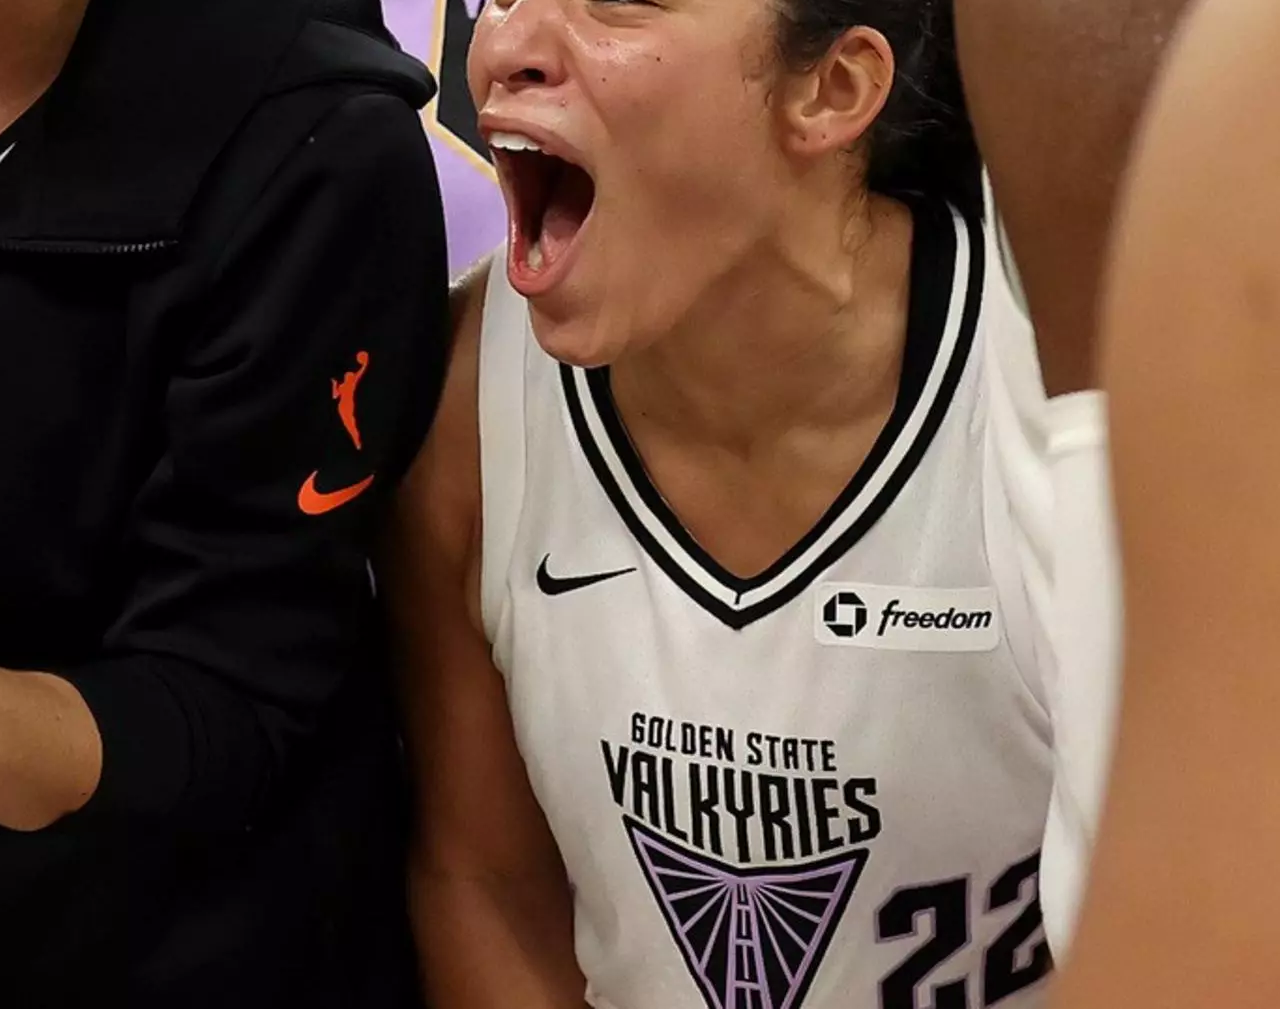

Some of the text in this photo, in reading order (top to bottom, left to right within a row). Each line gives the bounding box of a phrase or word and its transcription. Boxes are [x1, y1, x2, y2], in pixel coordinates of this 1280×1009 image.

[877, 599, 992, 637] freedom
[631, 712, 838, 773] GOLDEN STATE
[600, 738, 881, 864] VALKYRIES
[874, 847, 1055, 1009] 22
